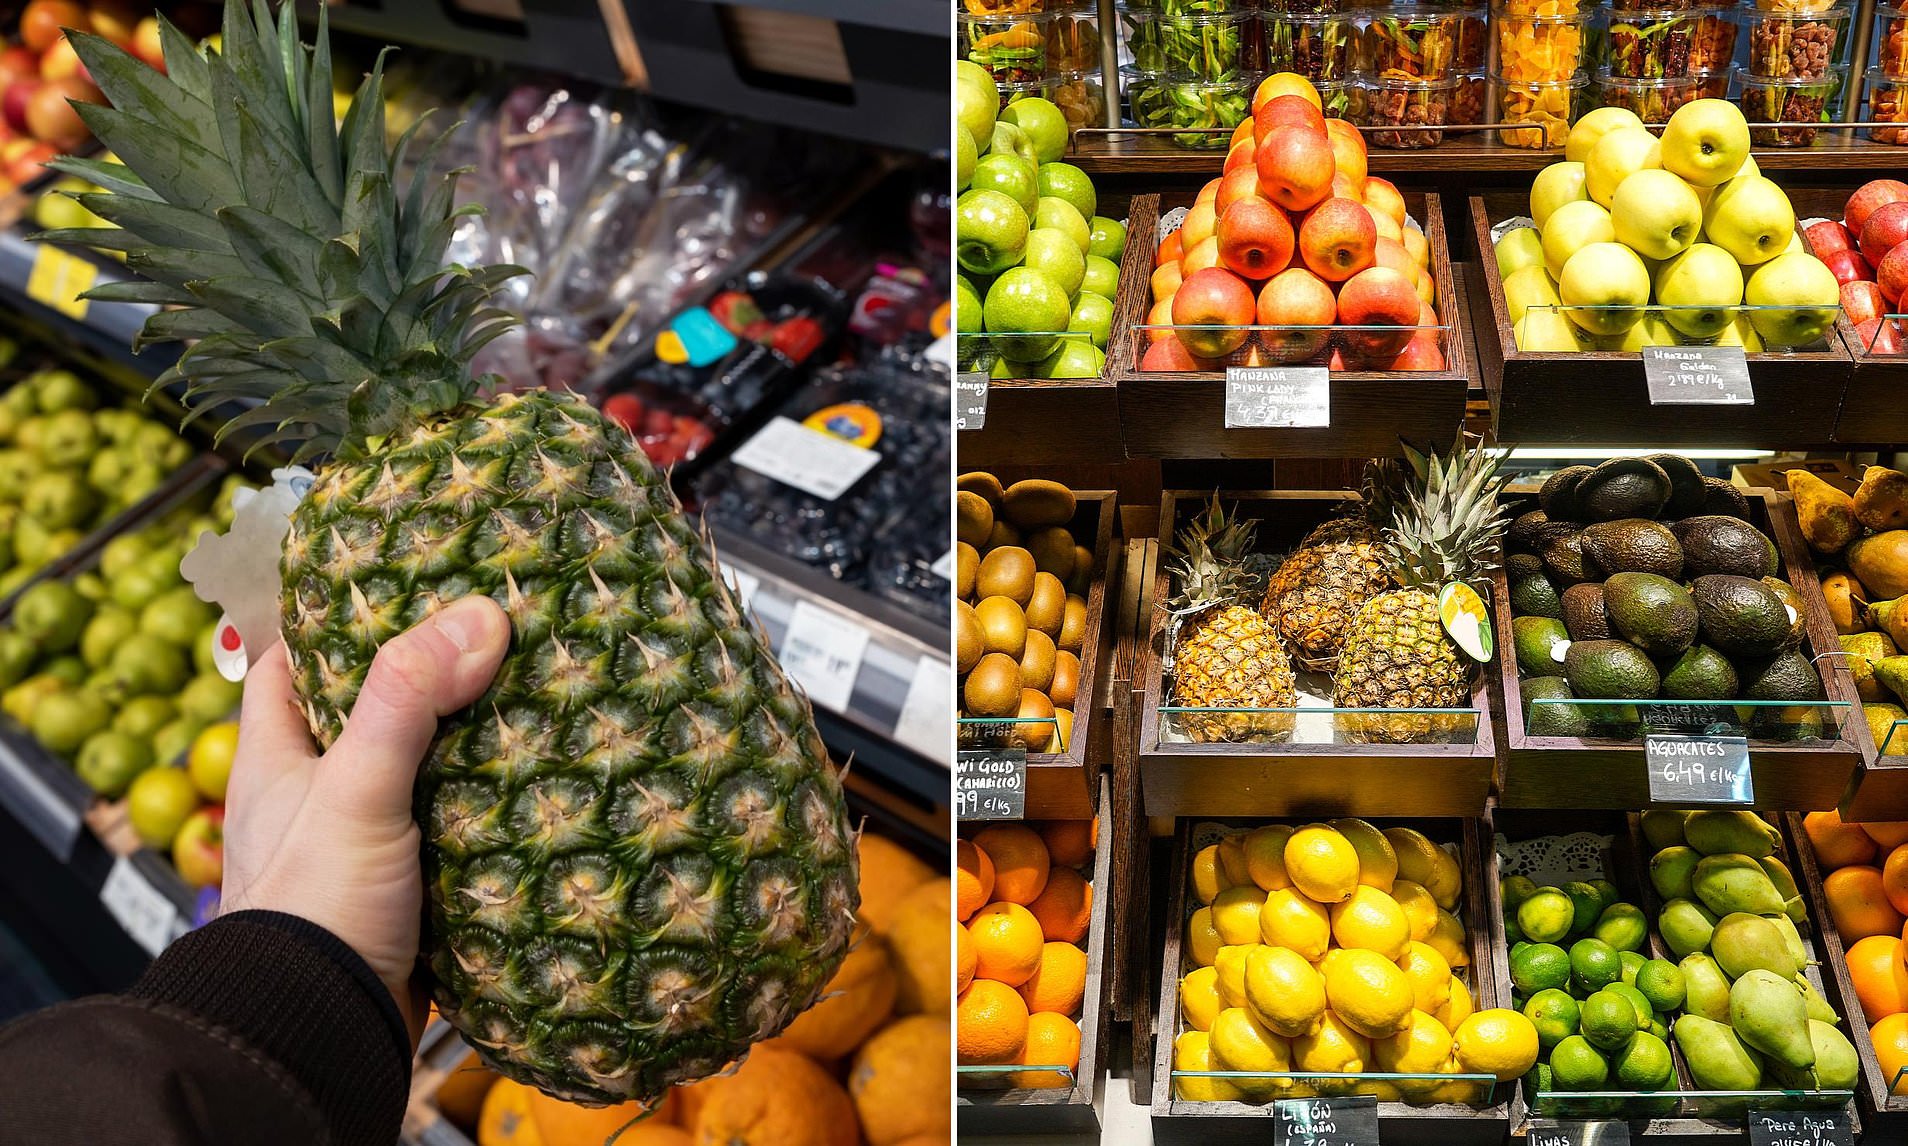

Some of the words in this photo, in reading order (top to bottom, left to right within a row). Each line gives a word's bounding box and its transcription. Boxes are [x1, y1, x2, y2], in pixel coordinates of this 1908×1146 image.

[1230, 382, 1264, 393] PINK
[1267, 384, 1296, 394] LADY
[1648, 739, 1725, 757] AGUACATES
[979, 757, 1014, 774] GOLD
